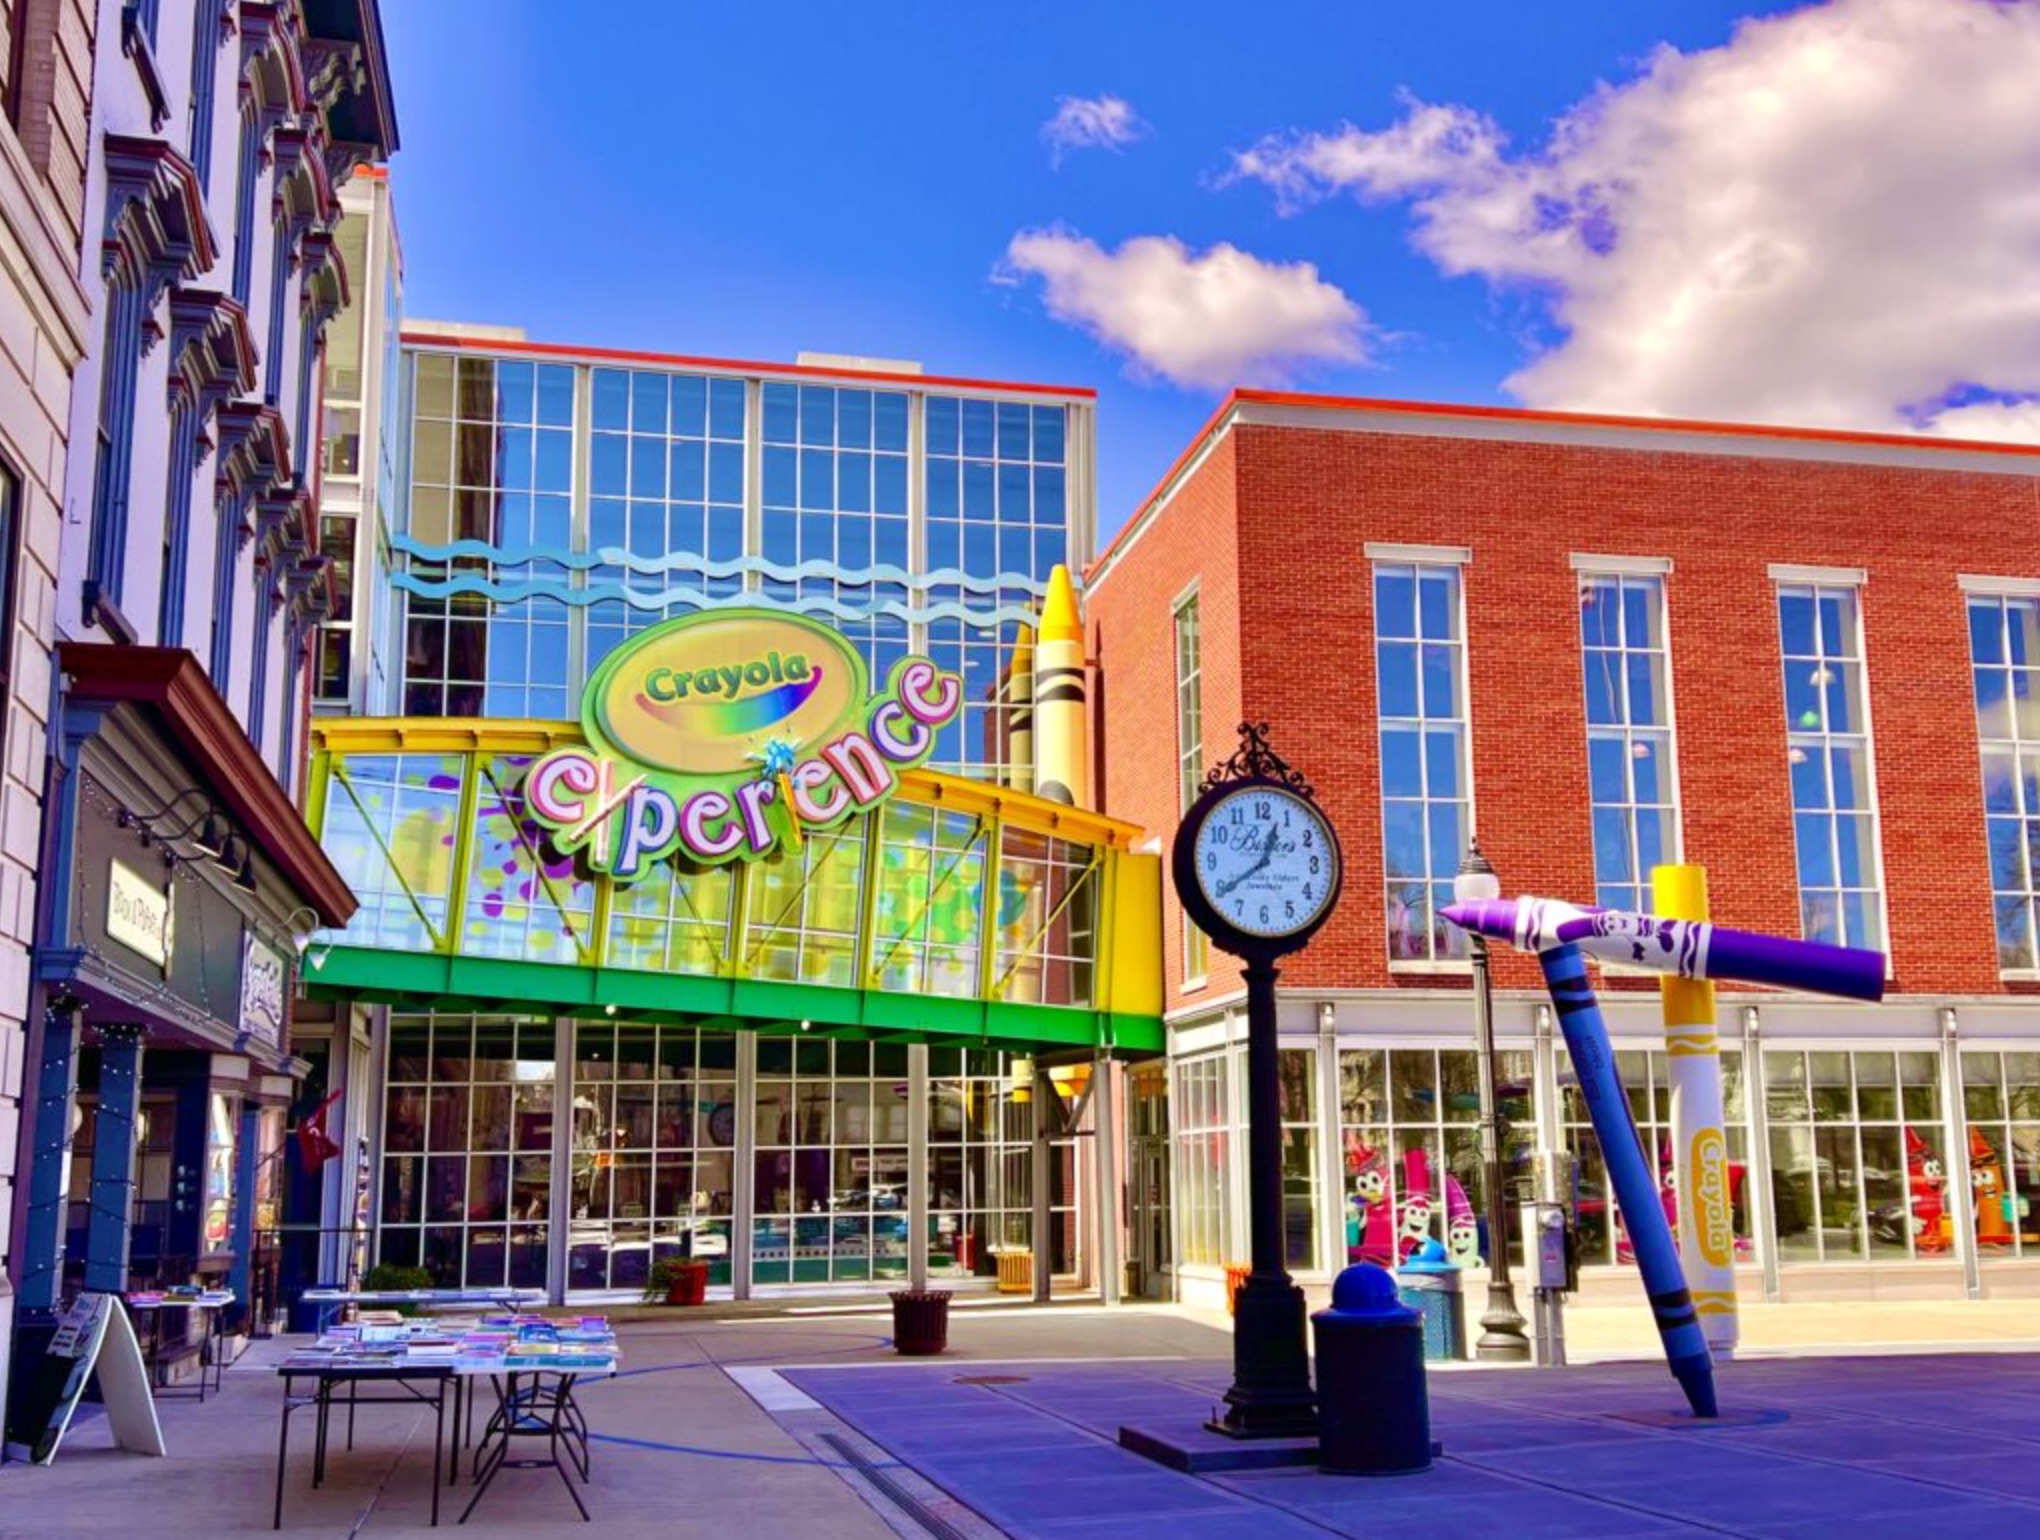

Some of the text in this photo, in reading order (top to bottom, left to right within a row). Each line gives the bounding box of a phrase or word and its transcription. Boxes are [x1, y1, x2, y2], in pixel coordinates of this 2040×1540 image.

[645, 651, 811, 700] Crayola
[1231, 807, 1244, 825] 11
[1255, 801, 1271, 820] 12
[1284, 810, 1290, 827] 1
[1211, 825, 1228, 844] 10
[1303, 830, 1313, 848] 2
[1207, 852, 1217, 871] 9
[1309, 855, 1319, 874] 3
[1216, 879, 1225, 898] 8
[1302, 882, 1312, 900] 4
[1235, 899, 1244, 916] 7
[1260, 905, 1269, 924] 6
[1285, 901, 1294, 918] 5
[1700, 1138, 1726, 1250] Crayola
